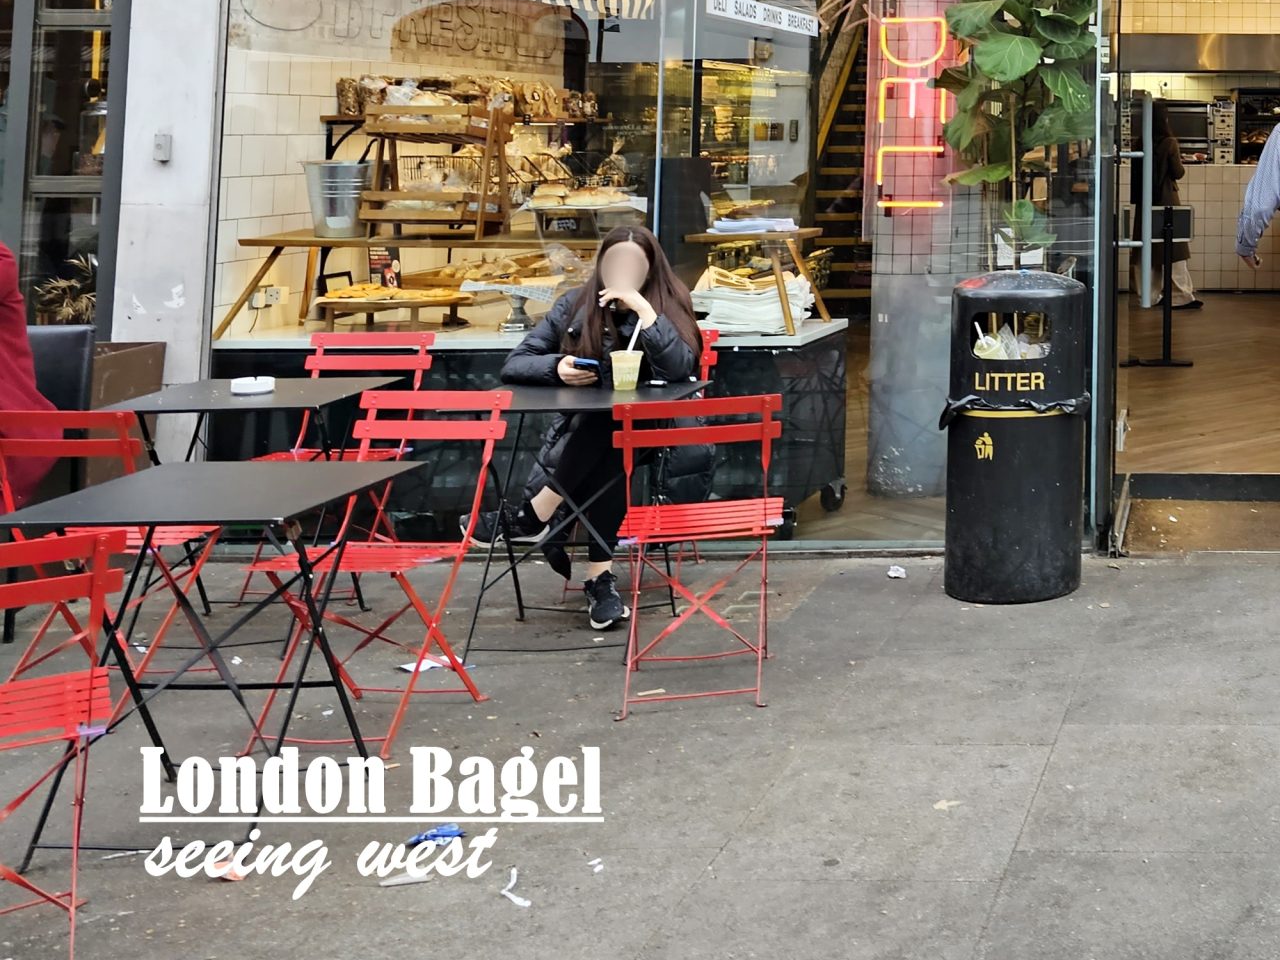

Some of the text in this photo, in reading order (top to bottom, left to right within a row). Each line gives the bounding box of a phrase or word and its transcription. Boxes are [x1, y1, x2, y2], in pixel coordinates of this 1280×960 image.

[734, 0, 757, 19] SALADS
[763, 7, 782, 25] DRINKS
[787, 13, 814, 33] BREAKFAST
[877, 17, 947, 208] DELI
[974, 372, 1045, 391] LITTER
